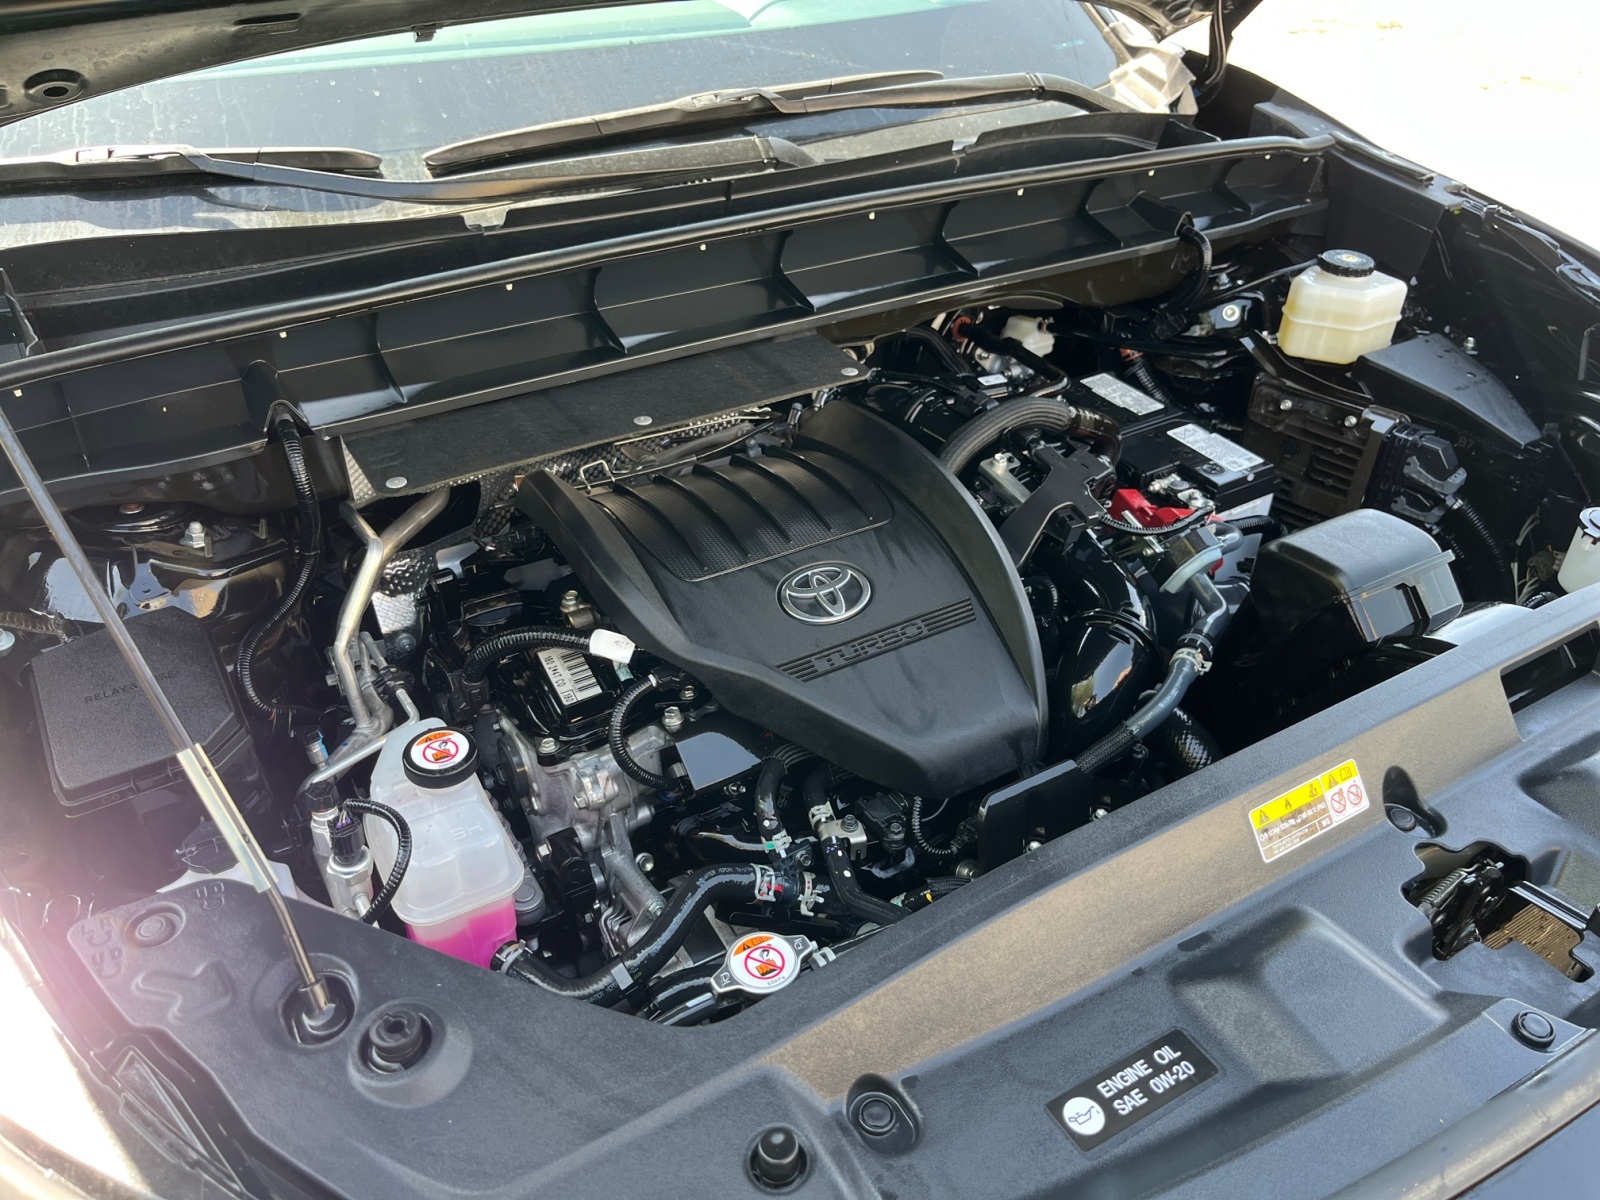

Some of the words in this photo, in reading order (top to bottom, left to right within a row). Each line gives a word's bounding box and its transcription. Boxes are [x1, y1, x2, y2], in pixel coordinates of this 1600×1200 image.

[813, 621, 924, 667] TURBO
[84, 685, 127, 704] RELAY
[1096, 1058, 1153, 1099] ENGINE
[1153, 1045, 1182, 1065] OIL
[1113, 1088, 1149, 1116] SAE
[1149, 1060, 1196, 1094] 0W-20
